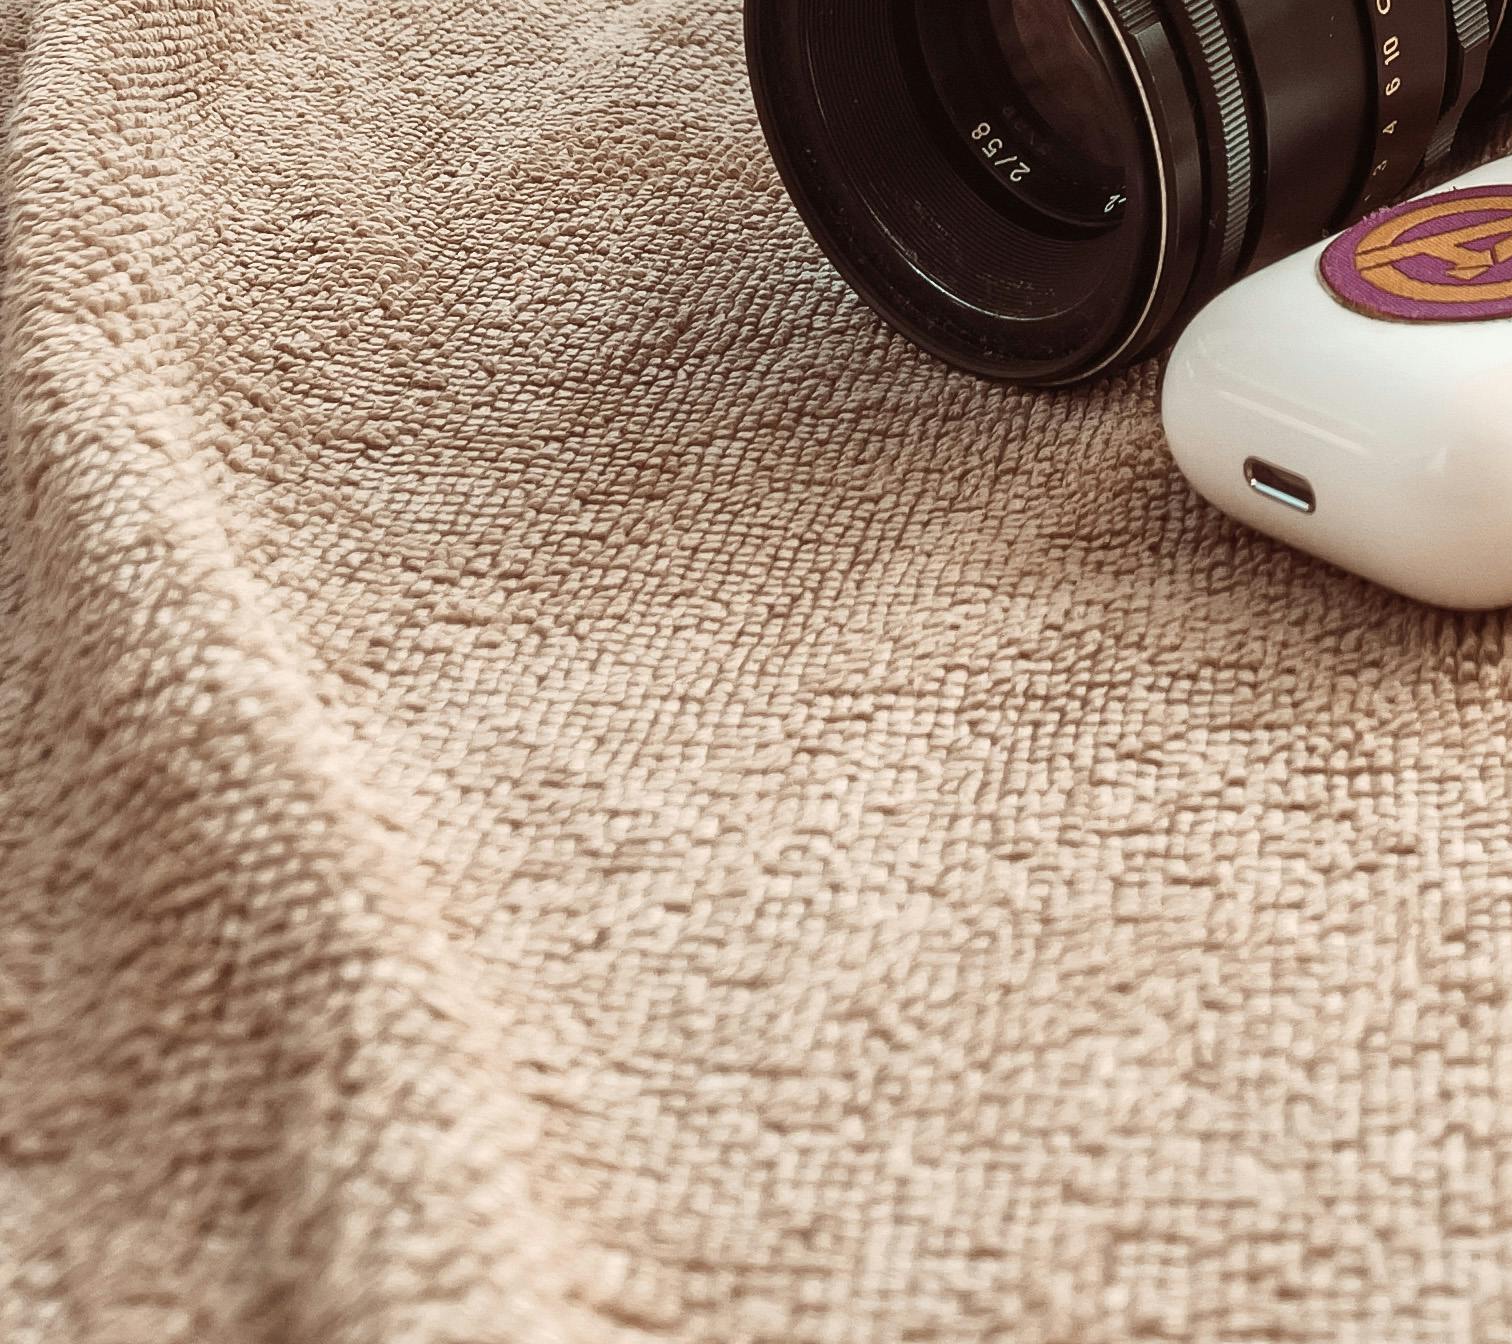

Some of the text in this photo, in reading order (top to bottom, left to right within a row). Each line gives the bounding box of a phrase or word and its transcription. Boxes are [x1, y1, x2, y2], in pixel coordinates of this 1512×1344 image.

[1383, 35, 1400, 66] 10
[1385, 77, 1401, 96] 6
[1382, 120, 1398, 134] 4
[971, 122, 1031, 182] 2/58
